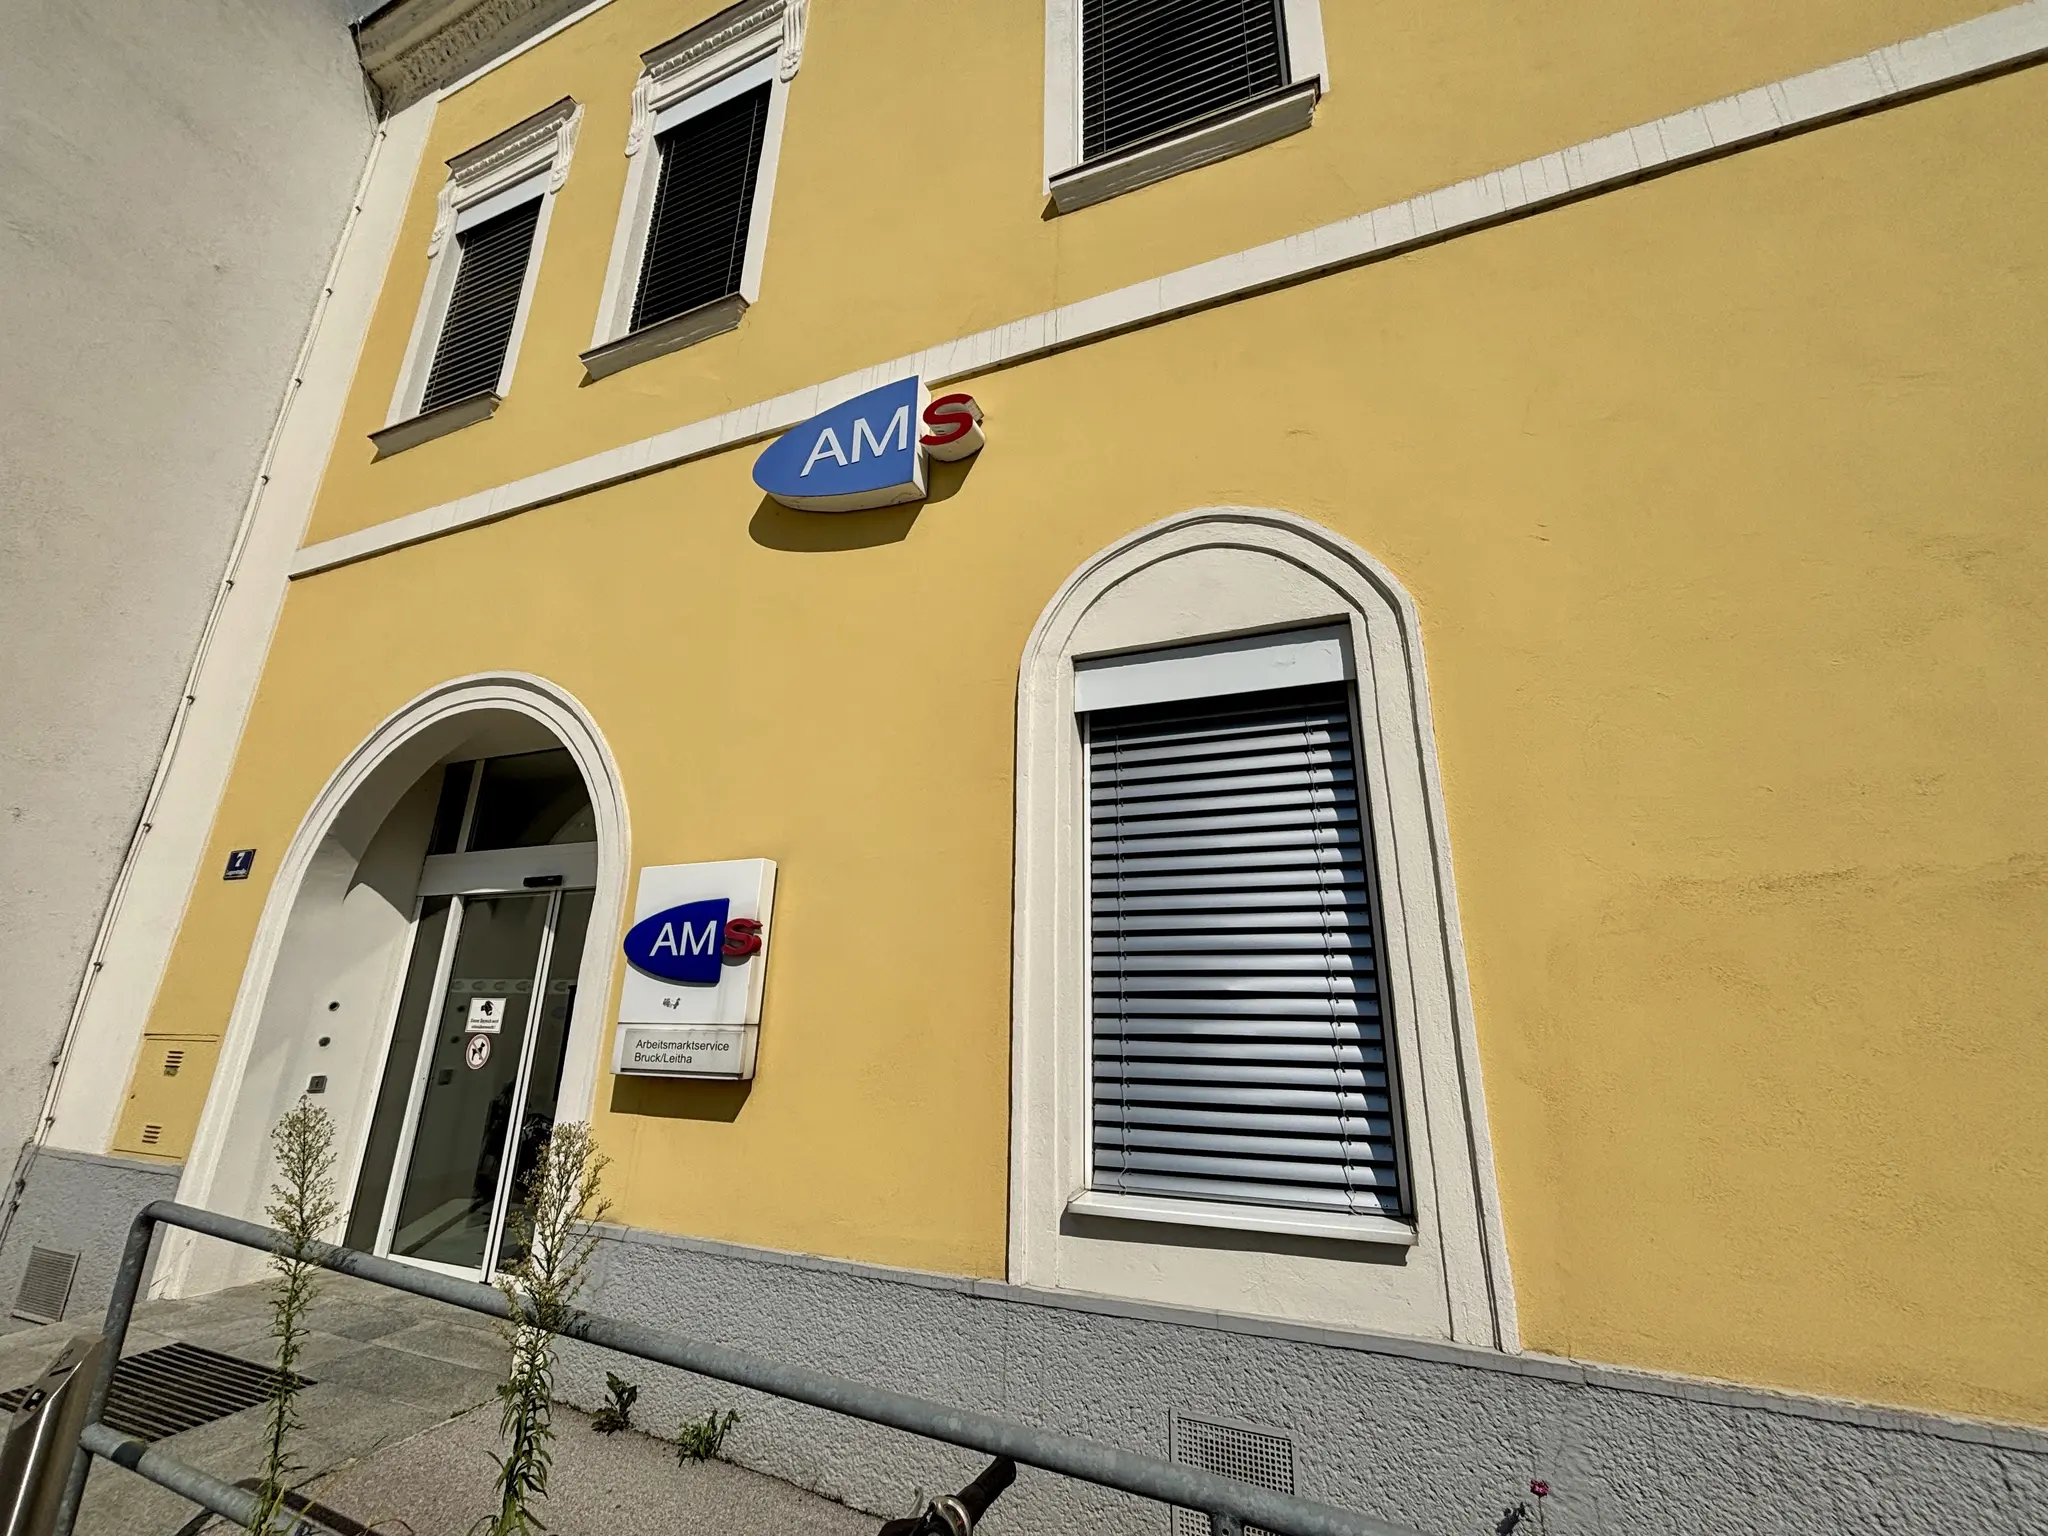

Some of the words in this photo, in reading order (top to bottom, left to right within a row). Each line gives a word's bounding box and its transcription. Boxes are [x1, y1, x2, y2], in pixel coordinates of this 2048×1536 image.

[800, 393, 975, 477] AMS
[234, 852, 246, 867] 7
[649, 918, 763, 957] AMS
[635, 1039, 730, 1052] Arbeitsmarktservice
[634, 1052, 693, 1064] Bruck/Leitha
